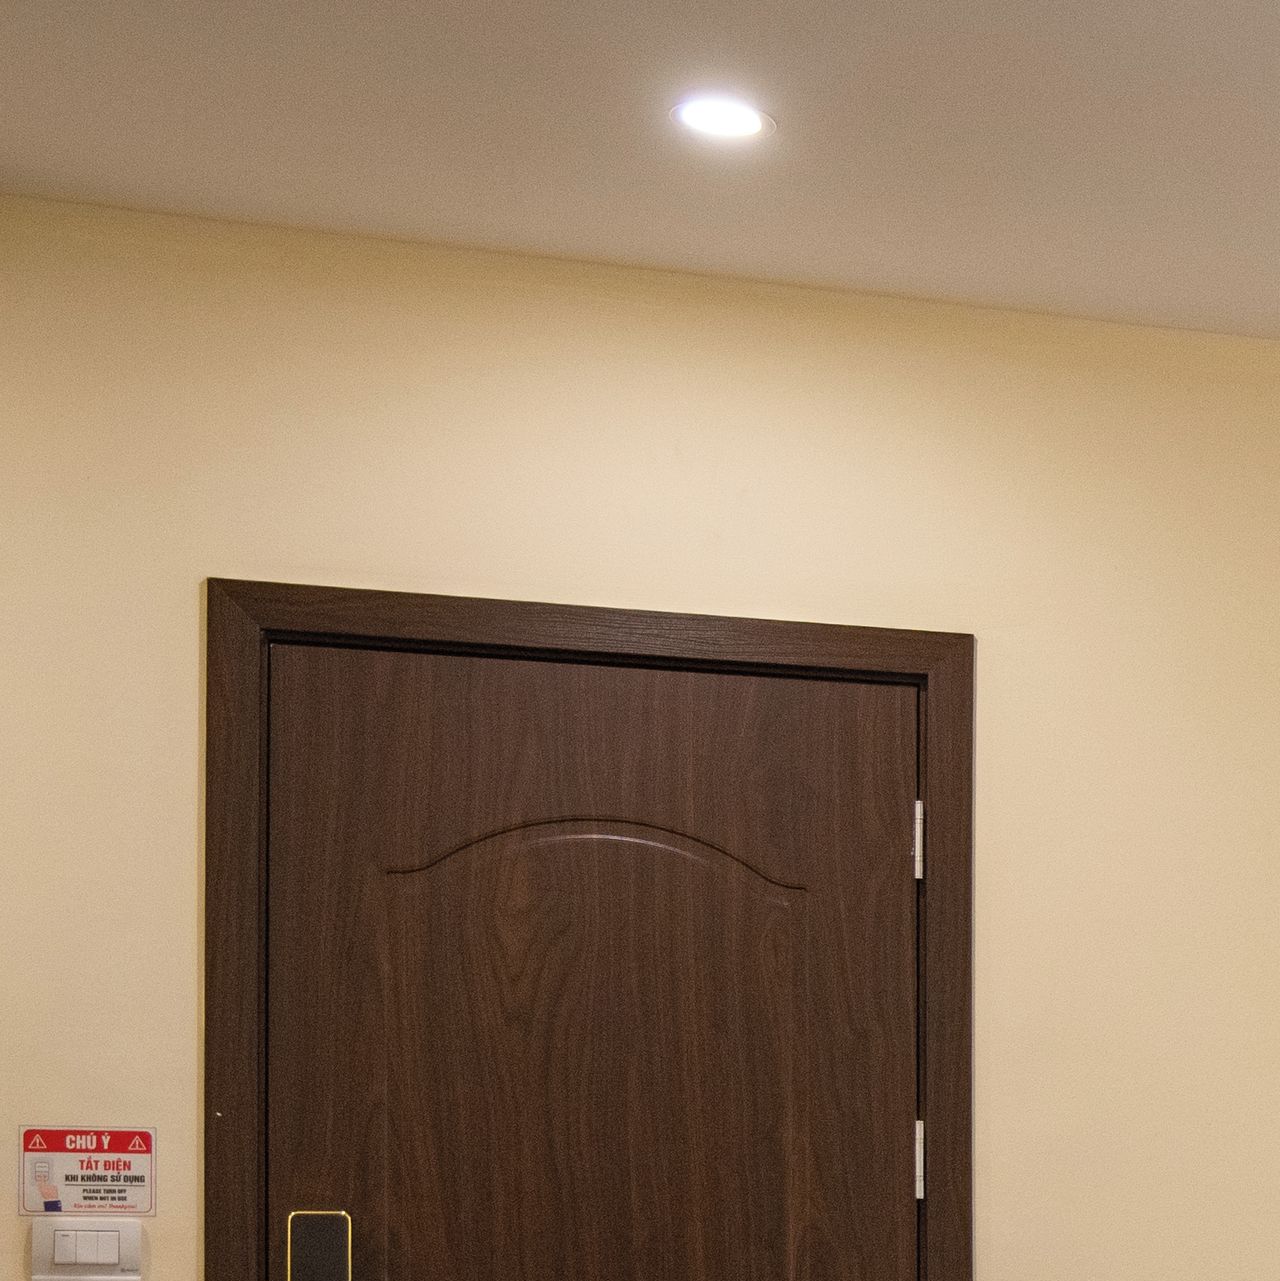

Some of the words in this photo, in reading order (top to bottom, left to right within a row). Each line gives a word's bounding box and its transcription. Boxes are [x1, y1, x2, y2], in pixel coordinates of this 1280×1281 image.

[66, 1132, 97, 1149] CHÚ
[102, 1132, 111, 1149] Ý
[65, 1174, 79, 1183] KHI
